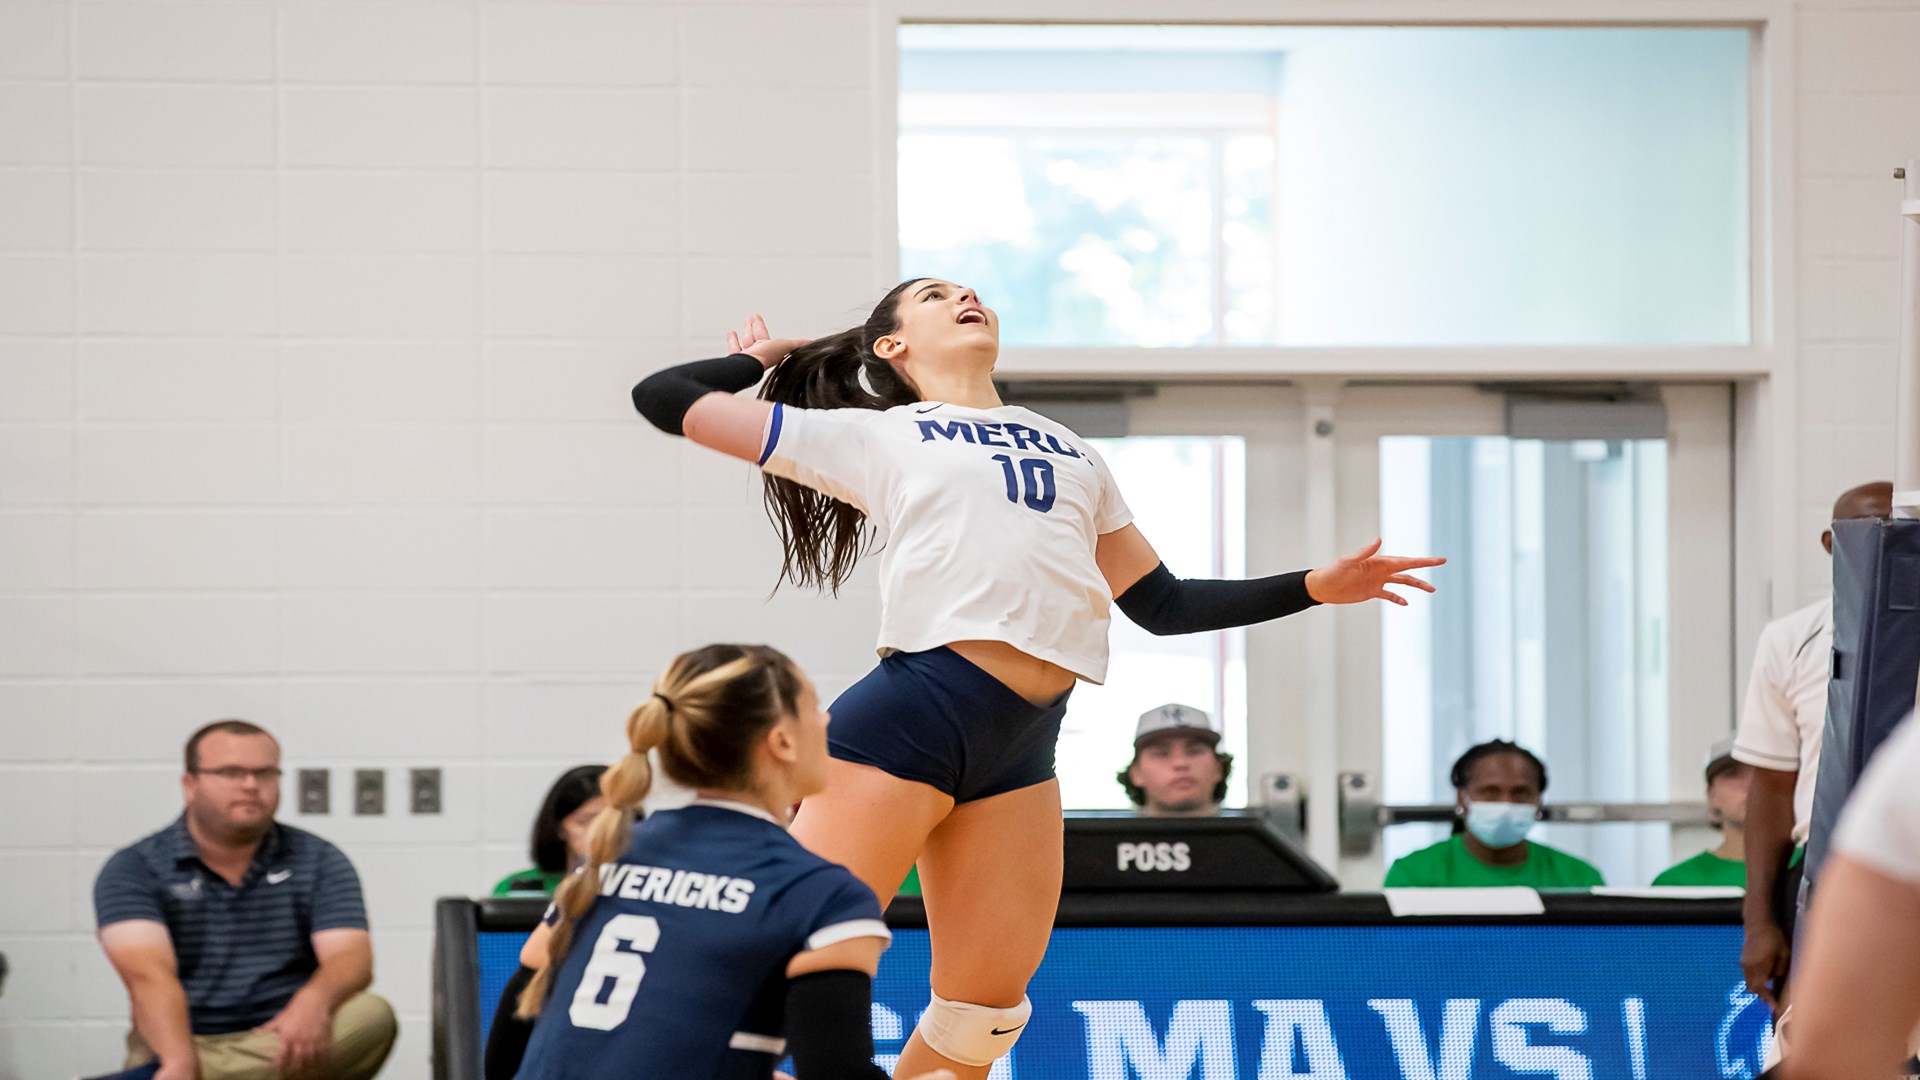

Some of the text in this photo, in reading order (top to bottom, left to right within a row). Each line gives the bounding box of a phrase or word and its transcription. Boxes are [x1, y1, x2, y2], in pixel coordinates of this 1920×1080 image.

[992, 454, 1056, 513] 10
[1117, 842, 1191, 872] POSS
[598, 863, 756, 914] VERICKS
[569, 913, 661, 1031] 6
